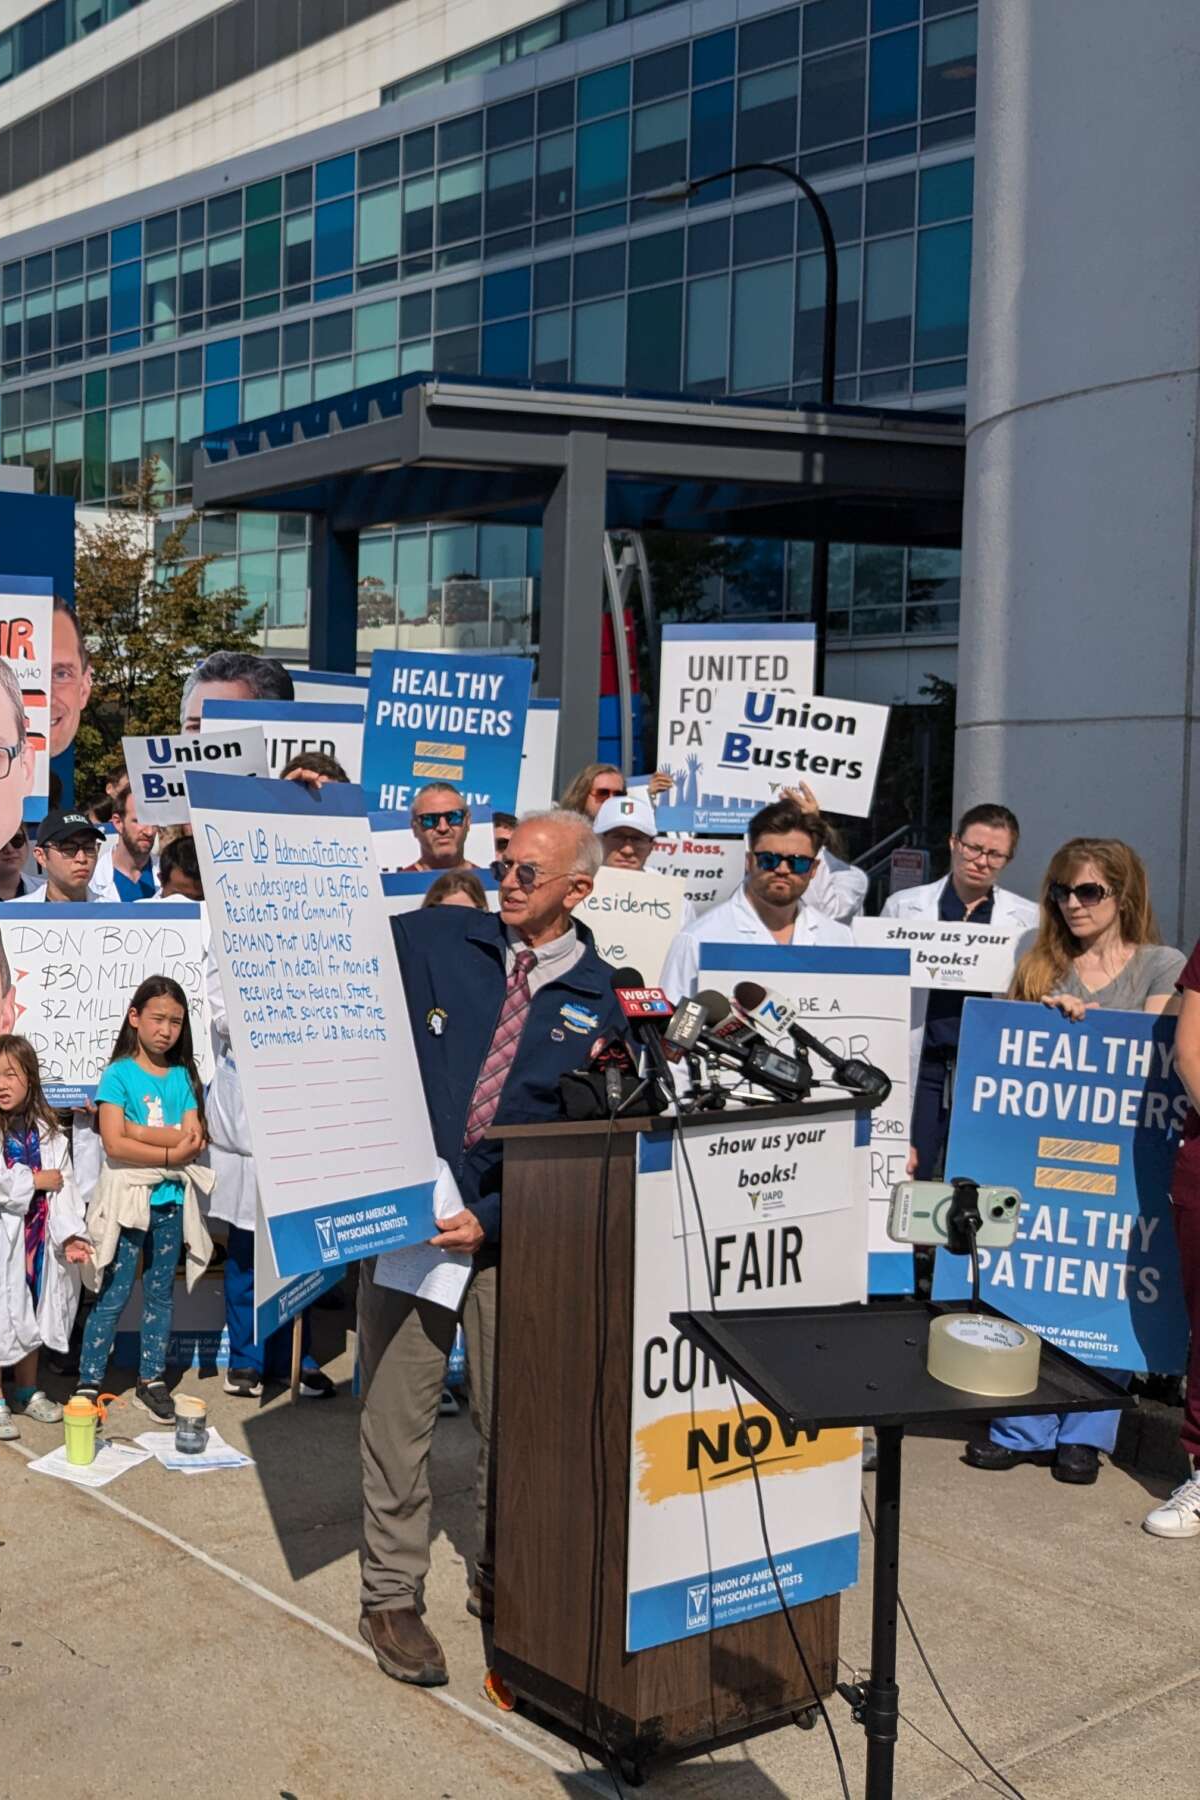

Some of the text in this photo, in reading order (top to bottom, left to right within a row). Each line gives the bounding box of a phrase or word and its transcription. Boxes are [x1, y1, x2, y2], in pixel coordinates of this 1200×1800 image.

[688, 655, 789, 682] UNITED
[392, 668, 503, 701] HEALTHY
[679, 688, 717, 714] FO
[744, 691, 857, 736] Union
[376, 701, 513, 736] PROVIDERS
[146, 737, 242, 764] Union
[721, 732, 863, 780] Busters
[204, 824, 245, 860] Dear
[248, 828, 269, 860] UB
[694, 867, 724, 879] not
[215, 873, 241, 899] The
[243, 871, 308, 902] undersigned
[326, 873, 369, 899] Buffalo
[684, 889, 717, 902] oss!
[225, 900, 353, 928] Residents and Community
[584, 892, 671, 920] esidents
[10, 926, 186, 958] DON BOYD
[222, 930, 274, 954] DEMAND
[276, 931, 298, 951] that
[886, 927, 1010, 946] show us your
[232, 959, 276, 979] account
[280, 957, 293, 977] in
[295, 957, 324, 977] detail
[916, 951, 979, 967] books!
[40, 963, 93, 994] $30
[941, 969, 964, 977] UAPD
[239, 983, 284, 1002] received
[620, 990, 662, 1001] WBFO
[830, 999, 841, 1012] A
[40, 998, 130, 1021] $2 MILLI
[244, 1005, 265, 1023] and
[300, 1005, 339, 1020] sources
[340, 1003, 365, 1020] that
[366, 1006, 386, 1020] are
[250, 1026, 303, 1049] earmarked
[340, 1023, 387, 1041] Residents
[682, 1015, 698, 1039] NEWS
[998, 1027, 1175, 1079] HEALTHY
[69, 1056, 111, 1081] MOR
[971, 1075, 1194, 1132] PROVIDERS
[707, 1127, 827, 1157] show us your
[738, 1162, 798, 1190] books!
[762, 1190, 783, 1200] UAPD
[333, 1204, 397, 1227] UNION OF AMERICAN
[1017, 1204, 1160, 1253] EALTHY
[337, 1216, 408, 1242] PHYSICIANS & DENTISTS
[712, 1226, 804, 1297] FAIR
[967, 1251, 1161, 1304] PATIENTS
[1046, 1326, 1059, 1335] OF
[1060, 1328, 1108, 1342] AMERICAN
[1068, 1339, 1077, 1348] &
[1077, 1340, 1120, 1353] DENTISTS
[711, 1578, 739, 1593] UNION
[739, 1575, 751, 1586] OF
[711, 1585, 759, 1608] PHYSICIANS
[759, 1583, 767, 1593] &
[688, 1614, 707, 1626] UAPD
